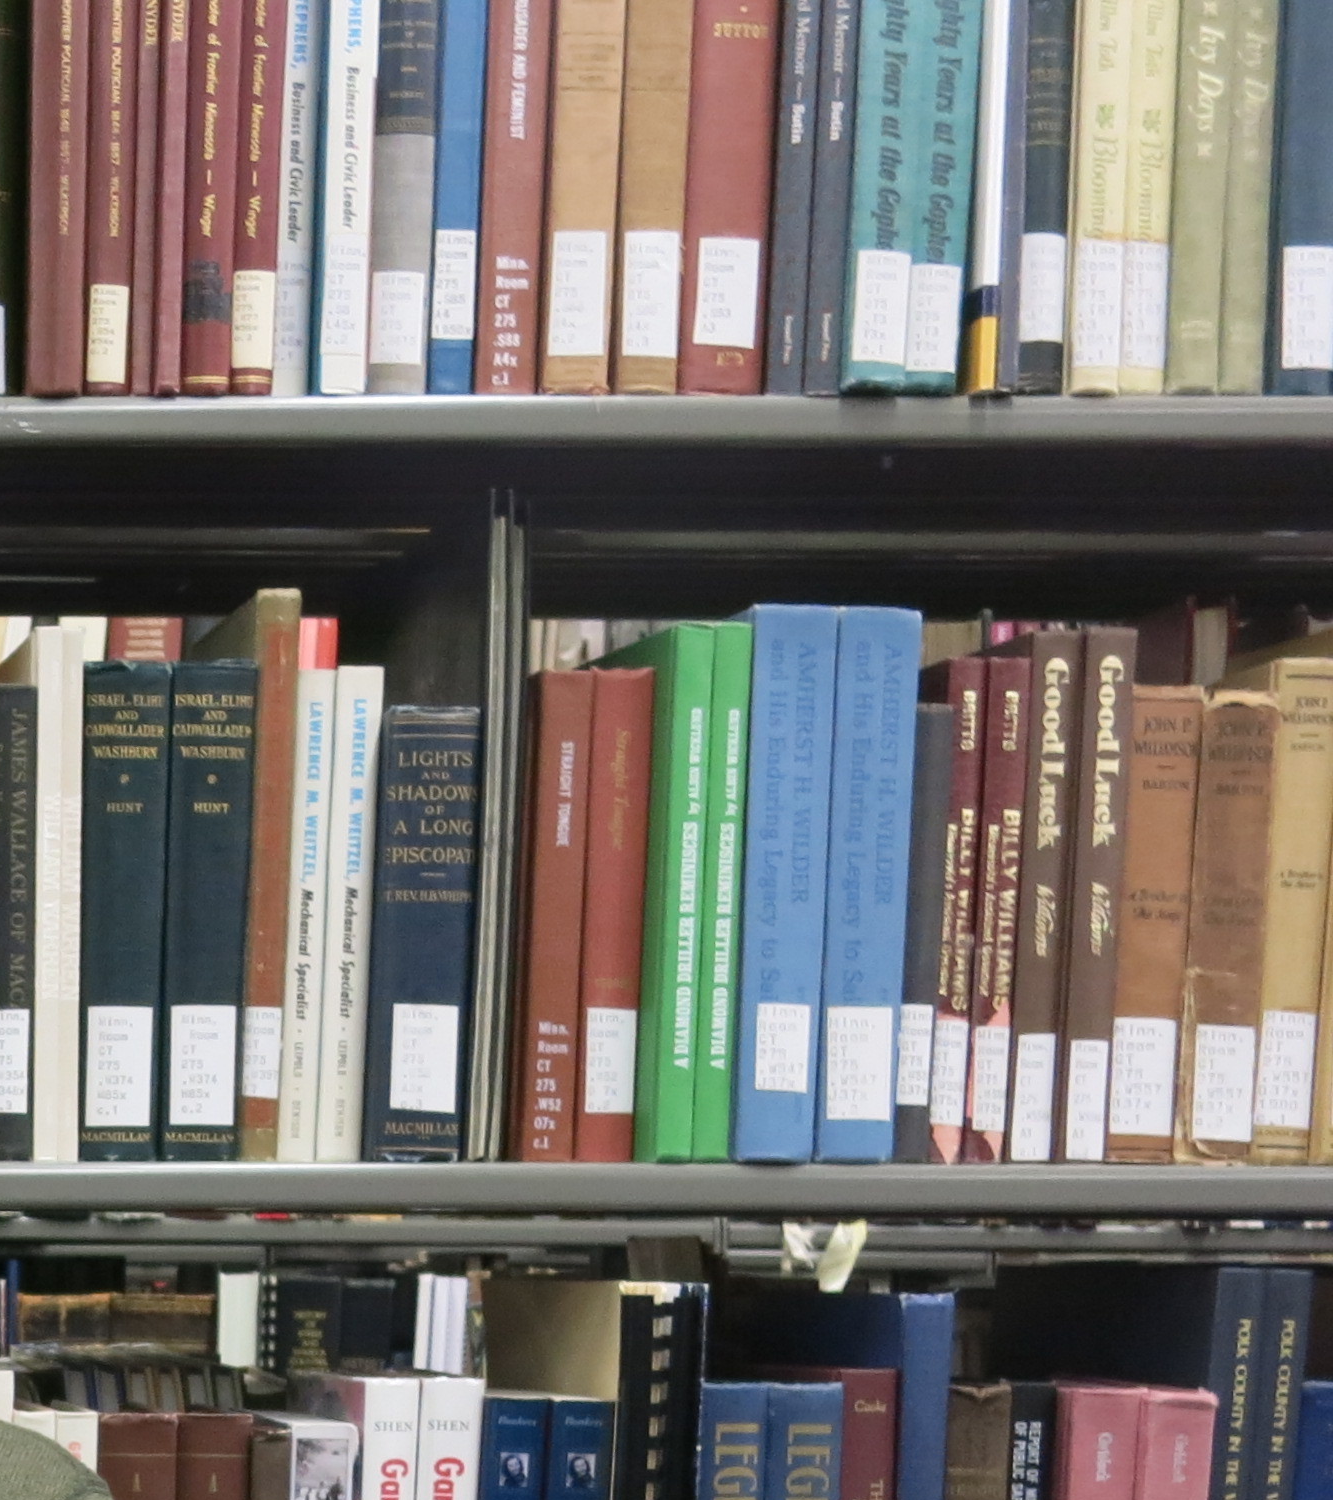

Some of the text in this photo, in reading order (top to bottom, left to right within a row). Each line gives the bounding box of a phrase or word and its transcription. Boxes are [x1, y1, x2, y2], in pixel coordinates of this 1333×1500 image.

[342, 66, 360, 229] Business and Civic Leader
[398, 750, 473, 768] LIGHTS
[1036, 657, 1070, 850] Good Luck
[193, 803, 229, 814] HUNT
[294, 701, 324, 1020] LAWRENCE M. WEITZEL, Mechanical Specialist
[374, 1420, 413, 1432] SHEN
